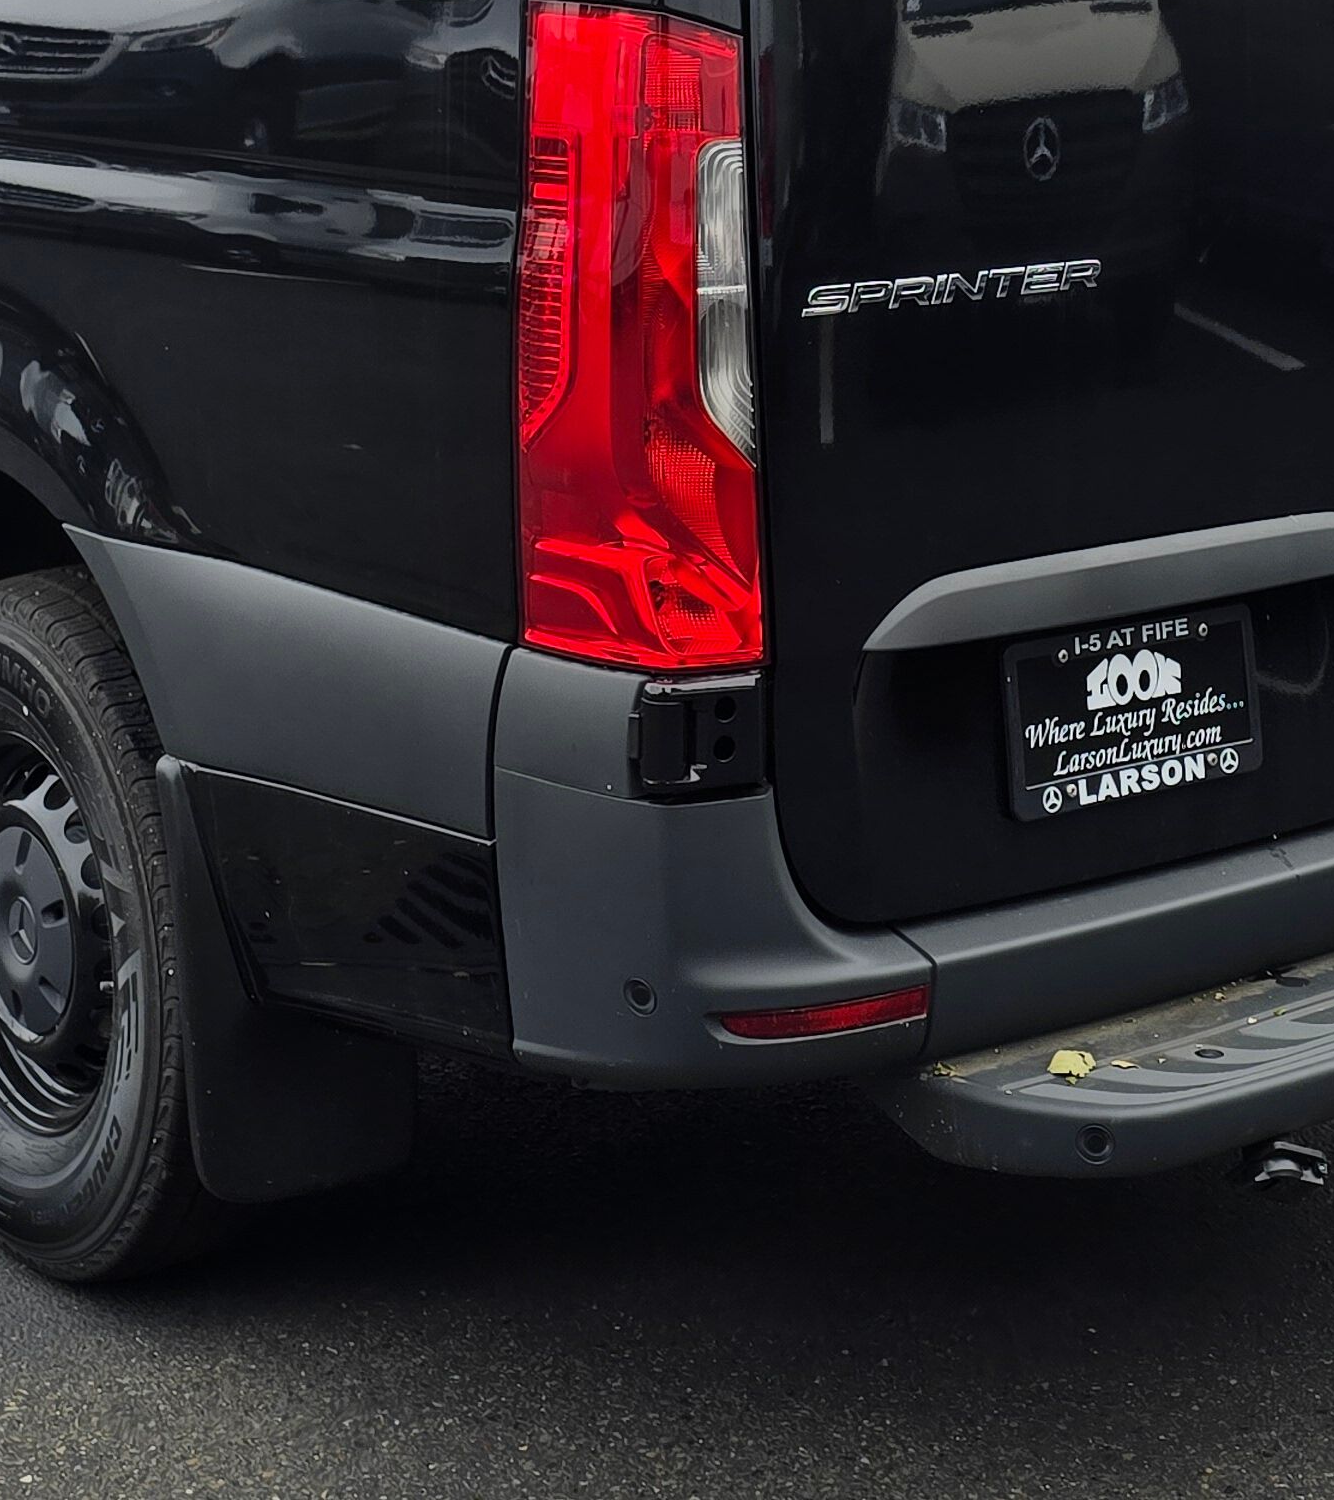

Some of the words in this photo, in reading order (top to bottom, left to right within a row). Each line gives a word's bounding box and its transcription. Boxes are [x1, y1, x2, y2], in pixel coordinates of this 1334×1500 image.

[802, 259, 1102, 317] SPRINTER
[1074, 633, 1101, 655] I-5
[1106, 627, 1135, 649] AT
[1141, 618, 1189, 644] FIFE
[1086, 649, 1182, 711] LOOK
[1025, 717, 1085, 749] Where
[1090, 706, 1157, 738] Luxury
[1161, 687, 1245, 725] Resides...
[1053, 725, 1223, 776] LarsonLuxury.com
[1078, 753, 1206, 806] LARSON
